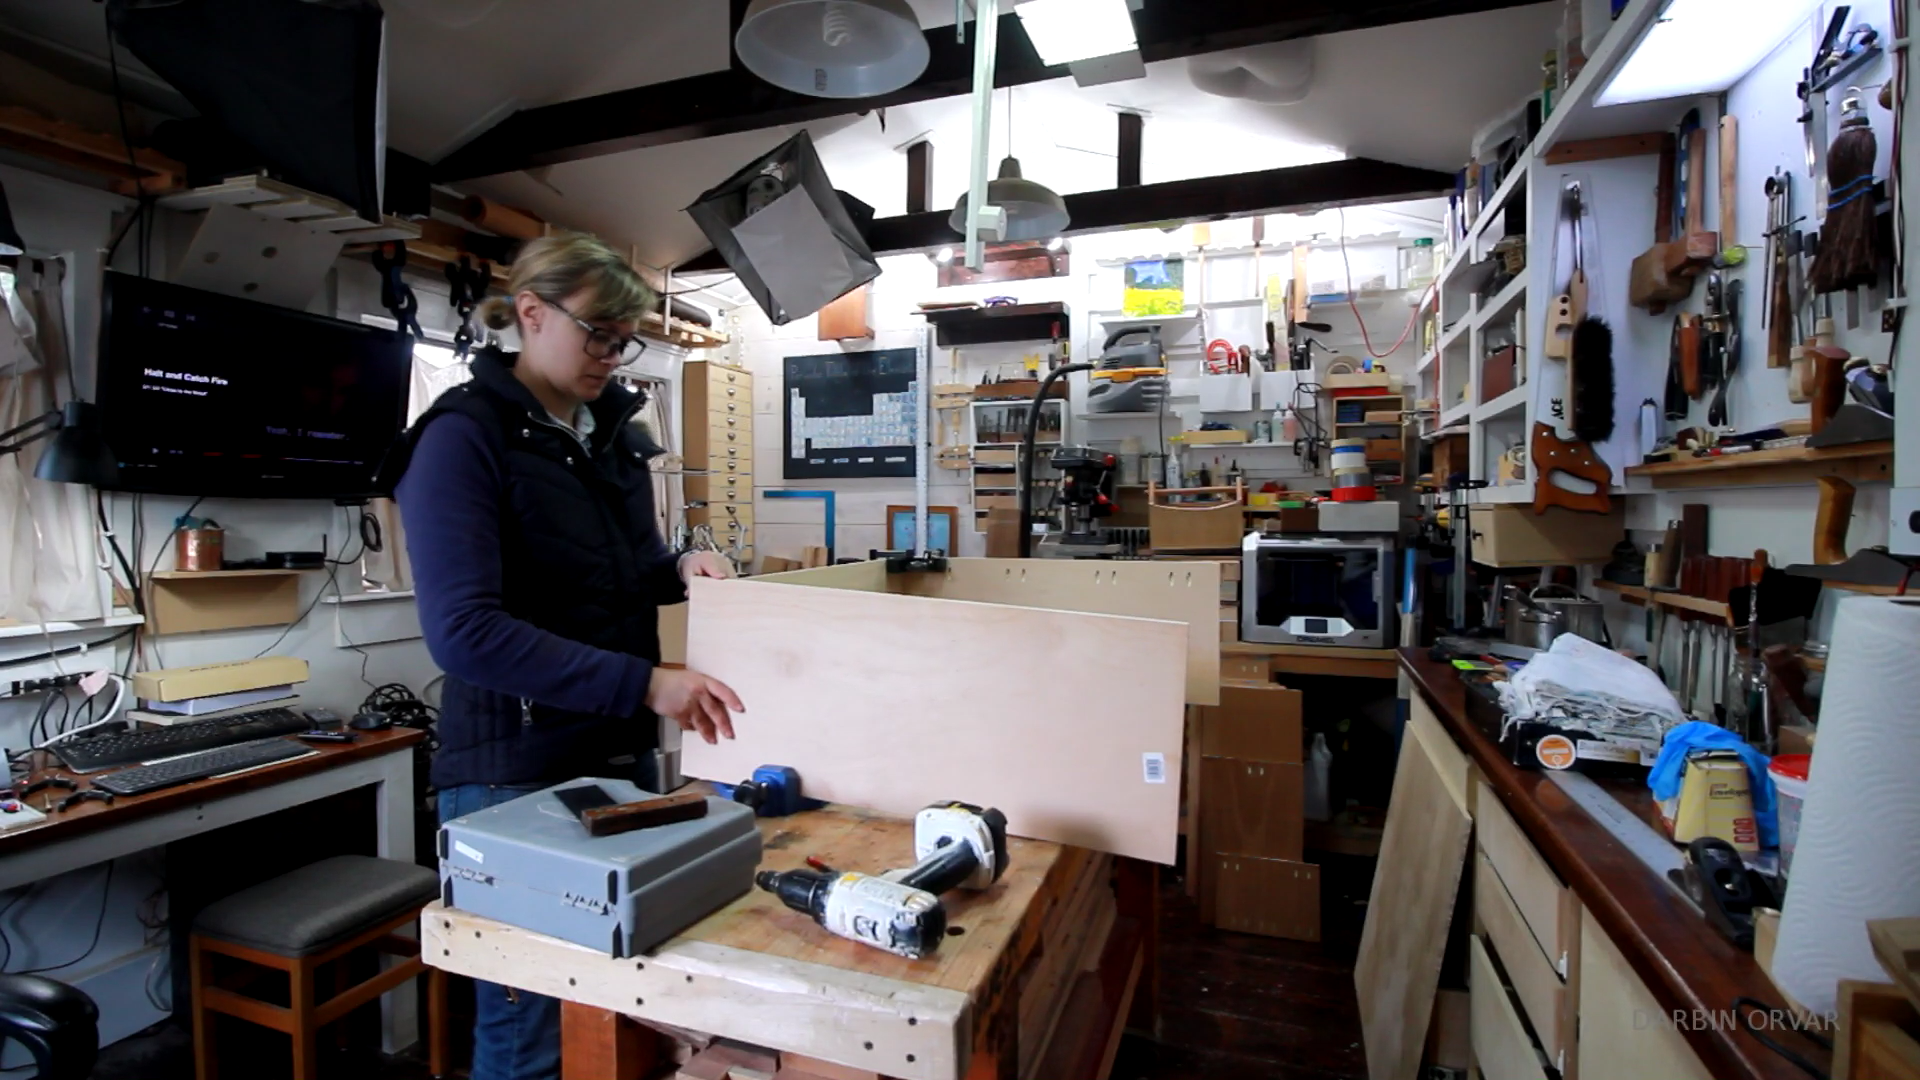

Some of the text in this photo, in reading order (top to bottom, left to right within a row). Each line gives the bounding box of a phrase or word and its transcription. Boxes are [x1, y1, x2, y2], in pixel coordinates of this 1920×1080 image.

[144, 368, 228, 386] Halt and Catch Fire
[1551, 398, 1564, 421] ACE
